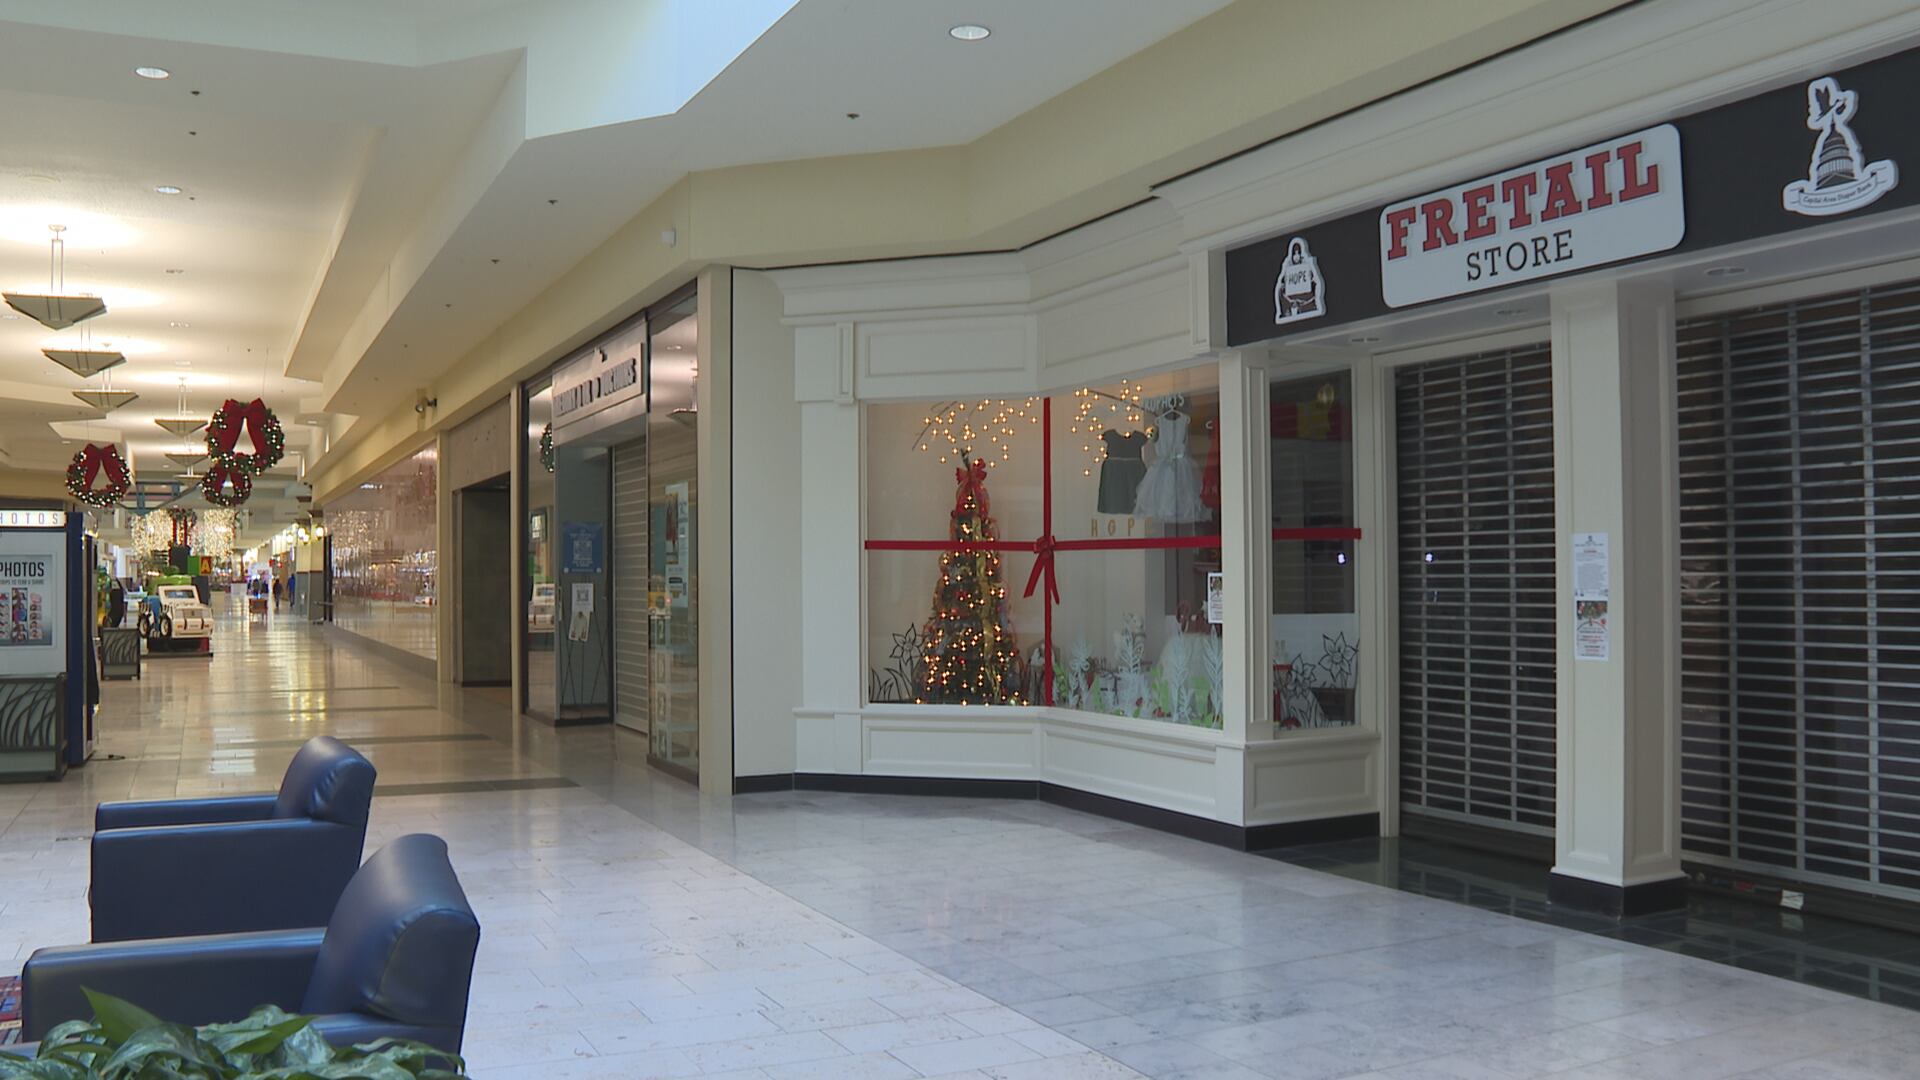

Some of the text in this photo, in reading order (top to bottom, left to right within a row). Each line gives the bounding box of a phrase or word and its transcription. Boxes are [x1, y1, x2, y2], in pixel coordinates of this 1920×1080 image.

[1386, 141, 1659, 260] FRETAIL
[1288, 270, 1307, 285] HOPE
[1467, 229, 1573, 281] STORE
